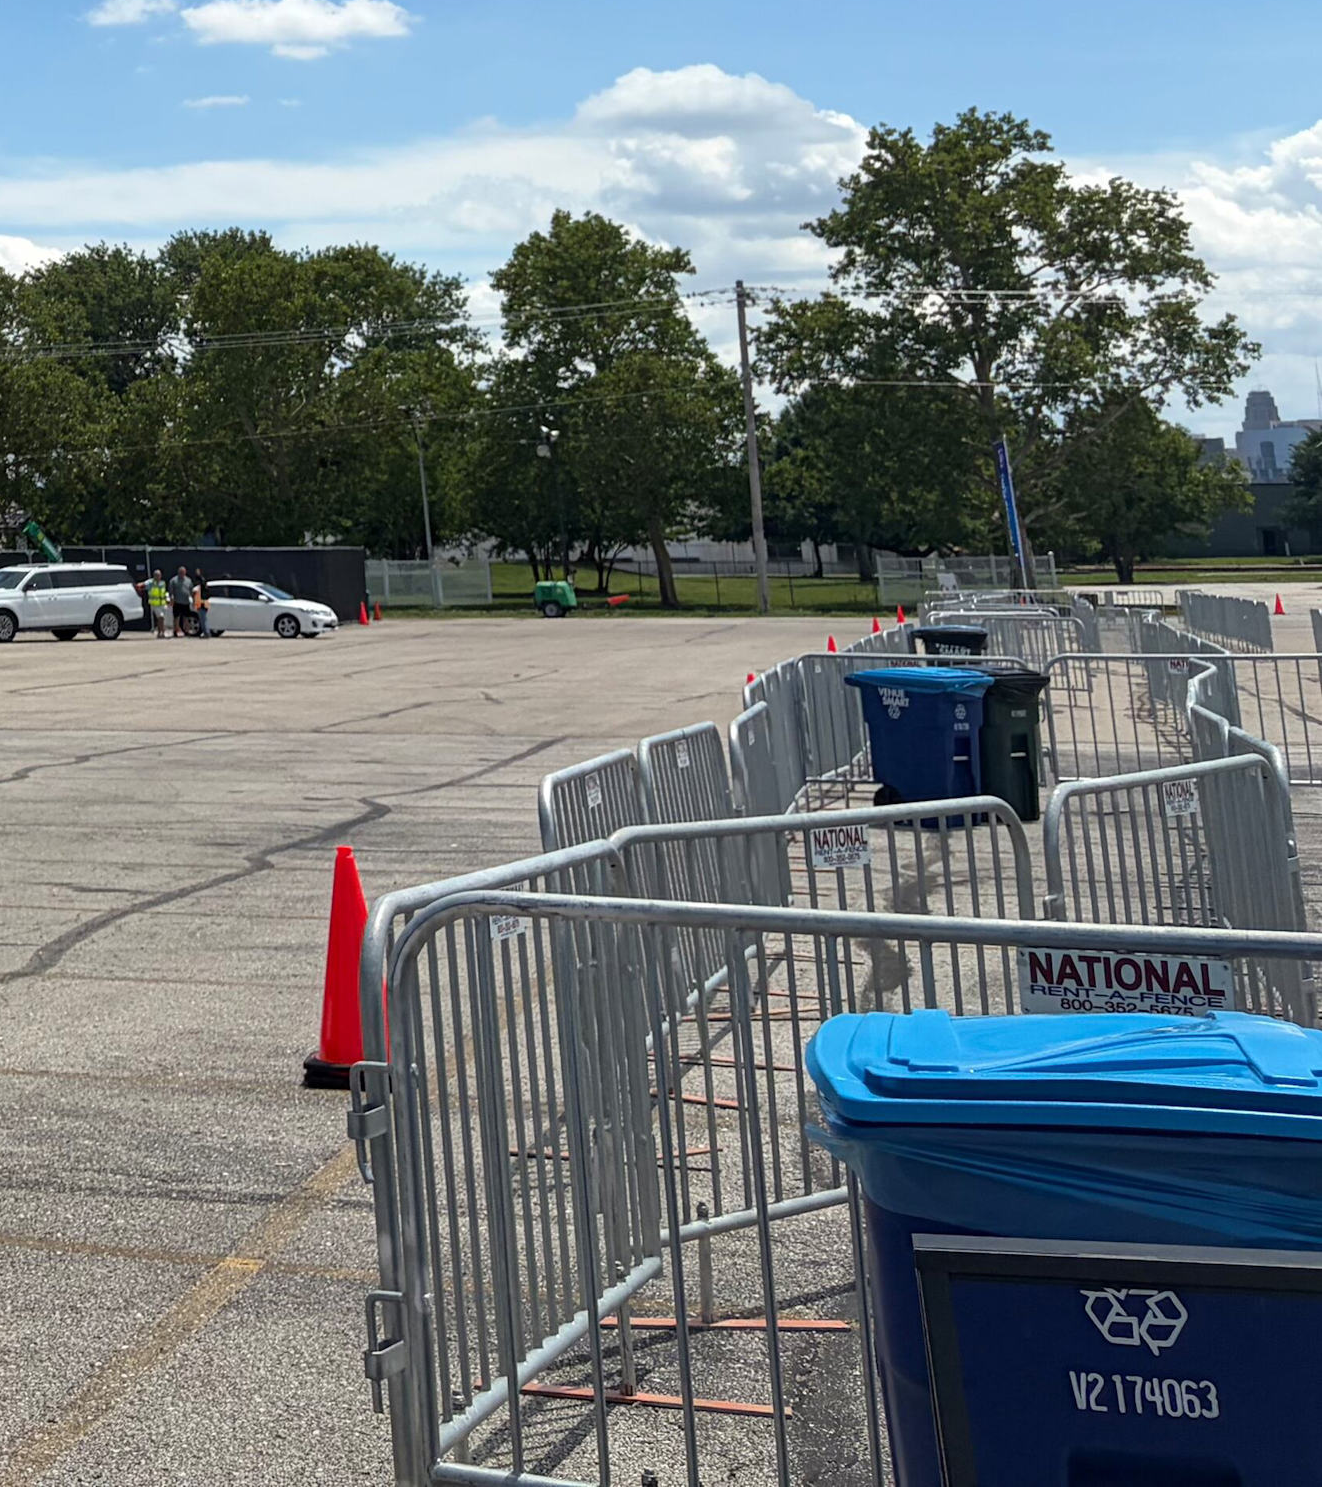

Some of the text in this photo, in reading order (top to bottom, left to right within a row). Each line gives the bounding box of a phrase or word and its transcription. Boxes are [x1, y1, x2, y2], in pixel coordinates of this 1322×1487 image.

[813, 826, 868, 849] NATIONAL
[1028, 951, 1225, 997] NATIONAL
[1030, 984, 1227, 1009] RENT-A-FENCE
